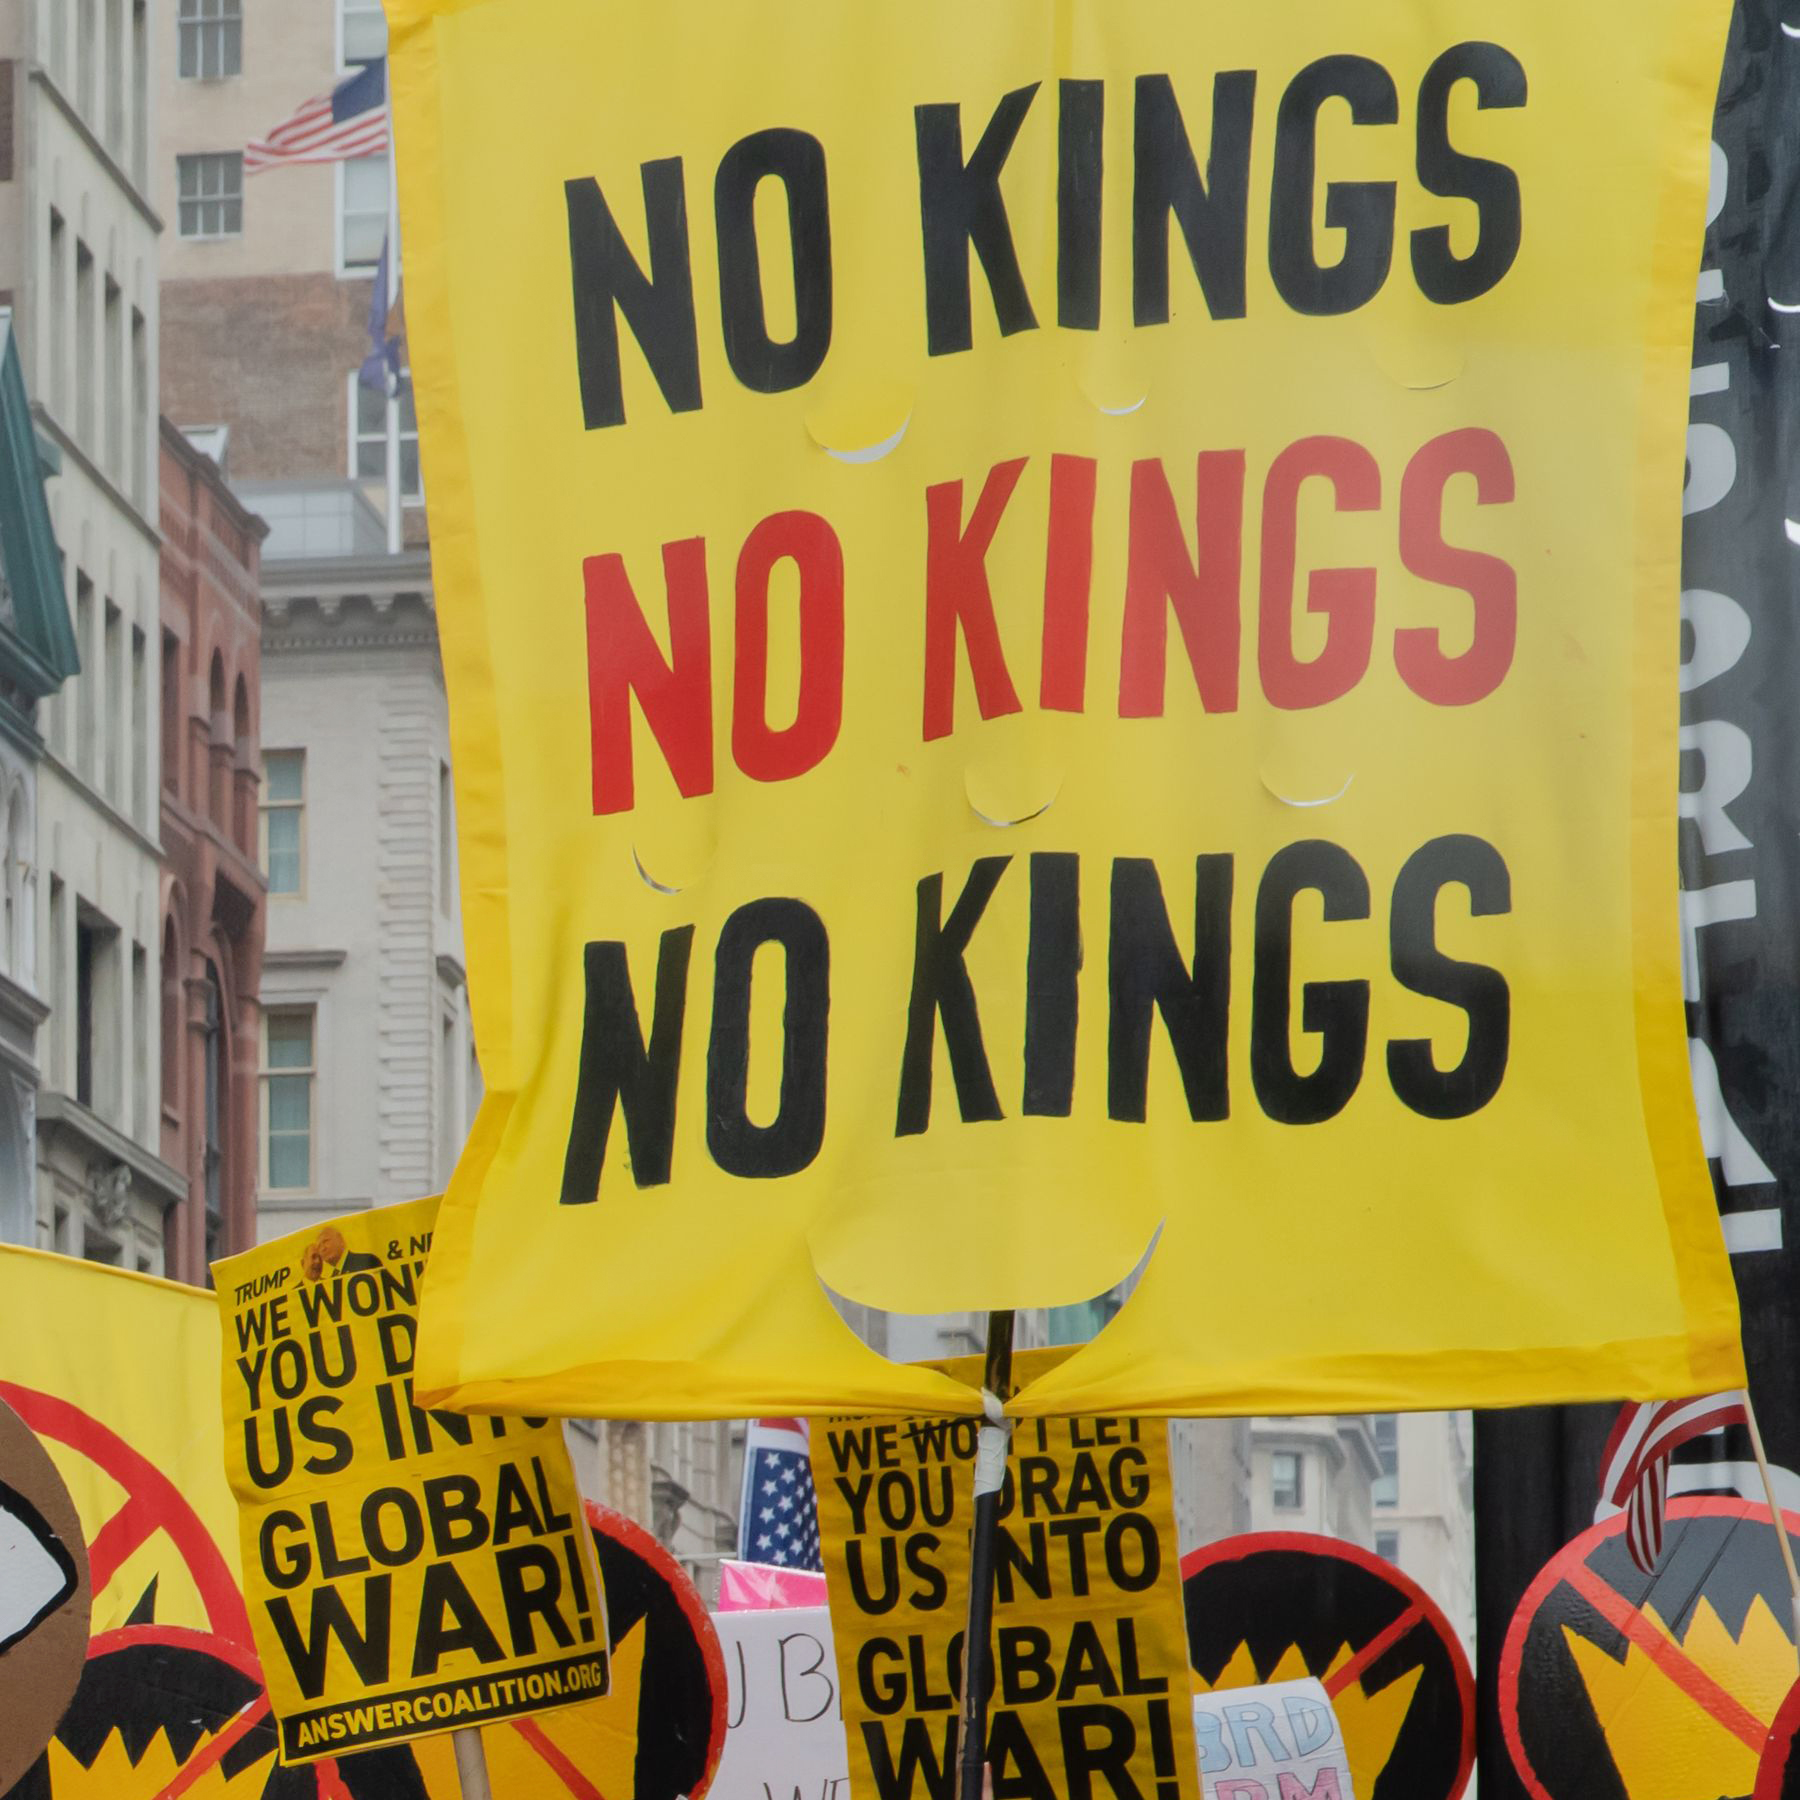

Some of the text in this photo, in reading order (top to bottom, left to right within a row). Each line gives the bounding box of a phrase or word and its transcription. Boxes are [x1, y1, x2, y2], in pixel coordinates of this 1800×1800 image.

[564, 40, 1529, 431] NO KINGS
[582, 426, 1519, 818] NO KINGS
[560, 833, 1514, 1207] NO KINGS
[234, 1266, 291, 1306] TRUMP
[234, 1294, 291, 1353] WE
[236, 1324, 357, 1413] YOU
[243, 1396, 354, 1490] US
[827, 1424, 901, 1473] WE
[259, 1456, 572, 1590] GLOBAL
[835, 1466, 955, 1534] YOU
[264, 1535, 595, 1700] WAR!
[842, 1534, 947, 1616] US
[297, 1660, 601, 1748] ANSWERCOALITION.ORG
